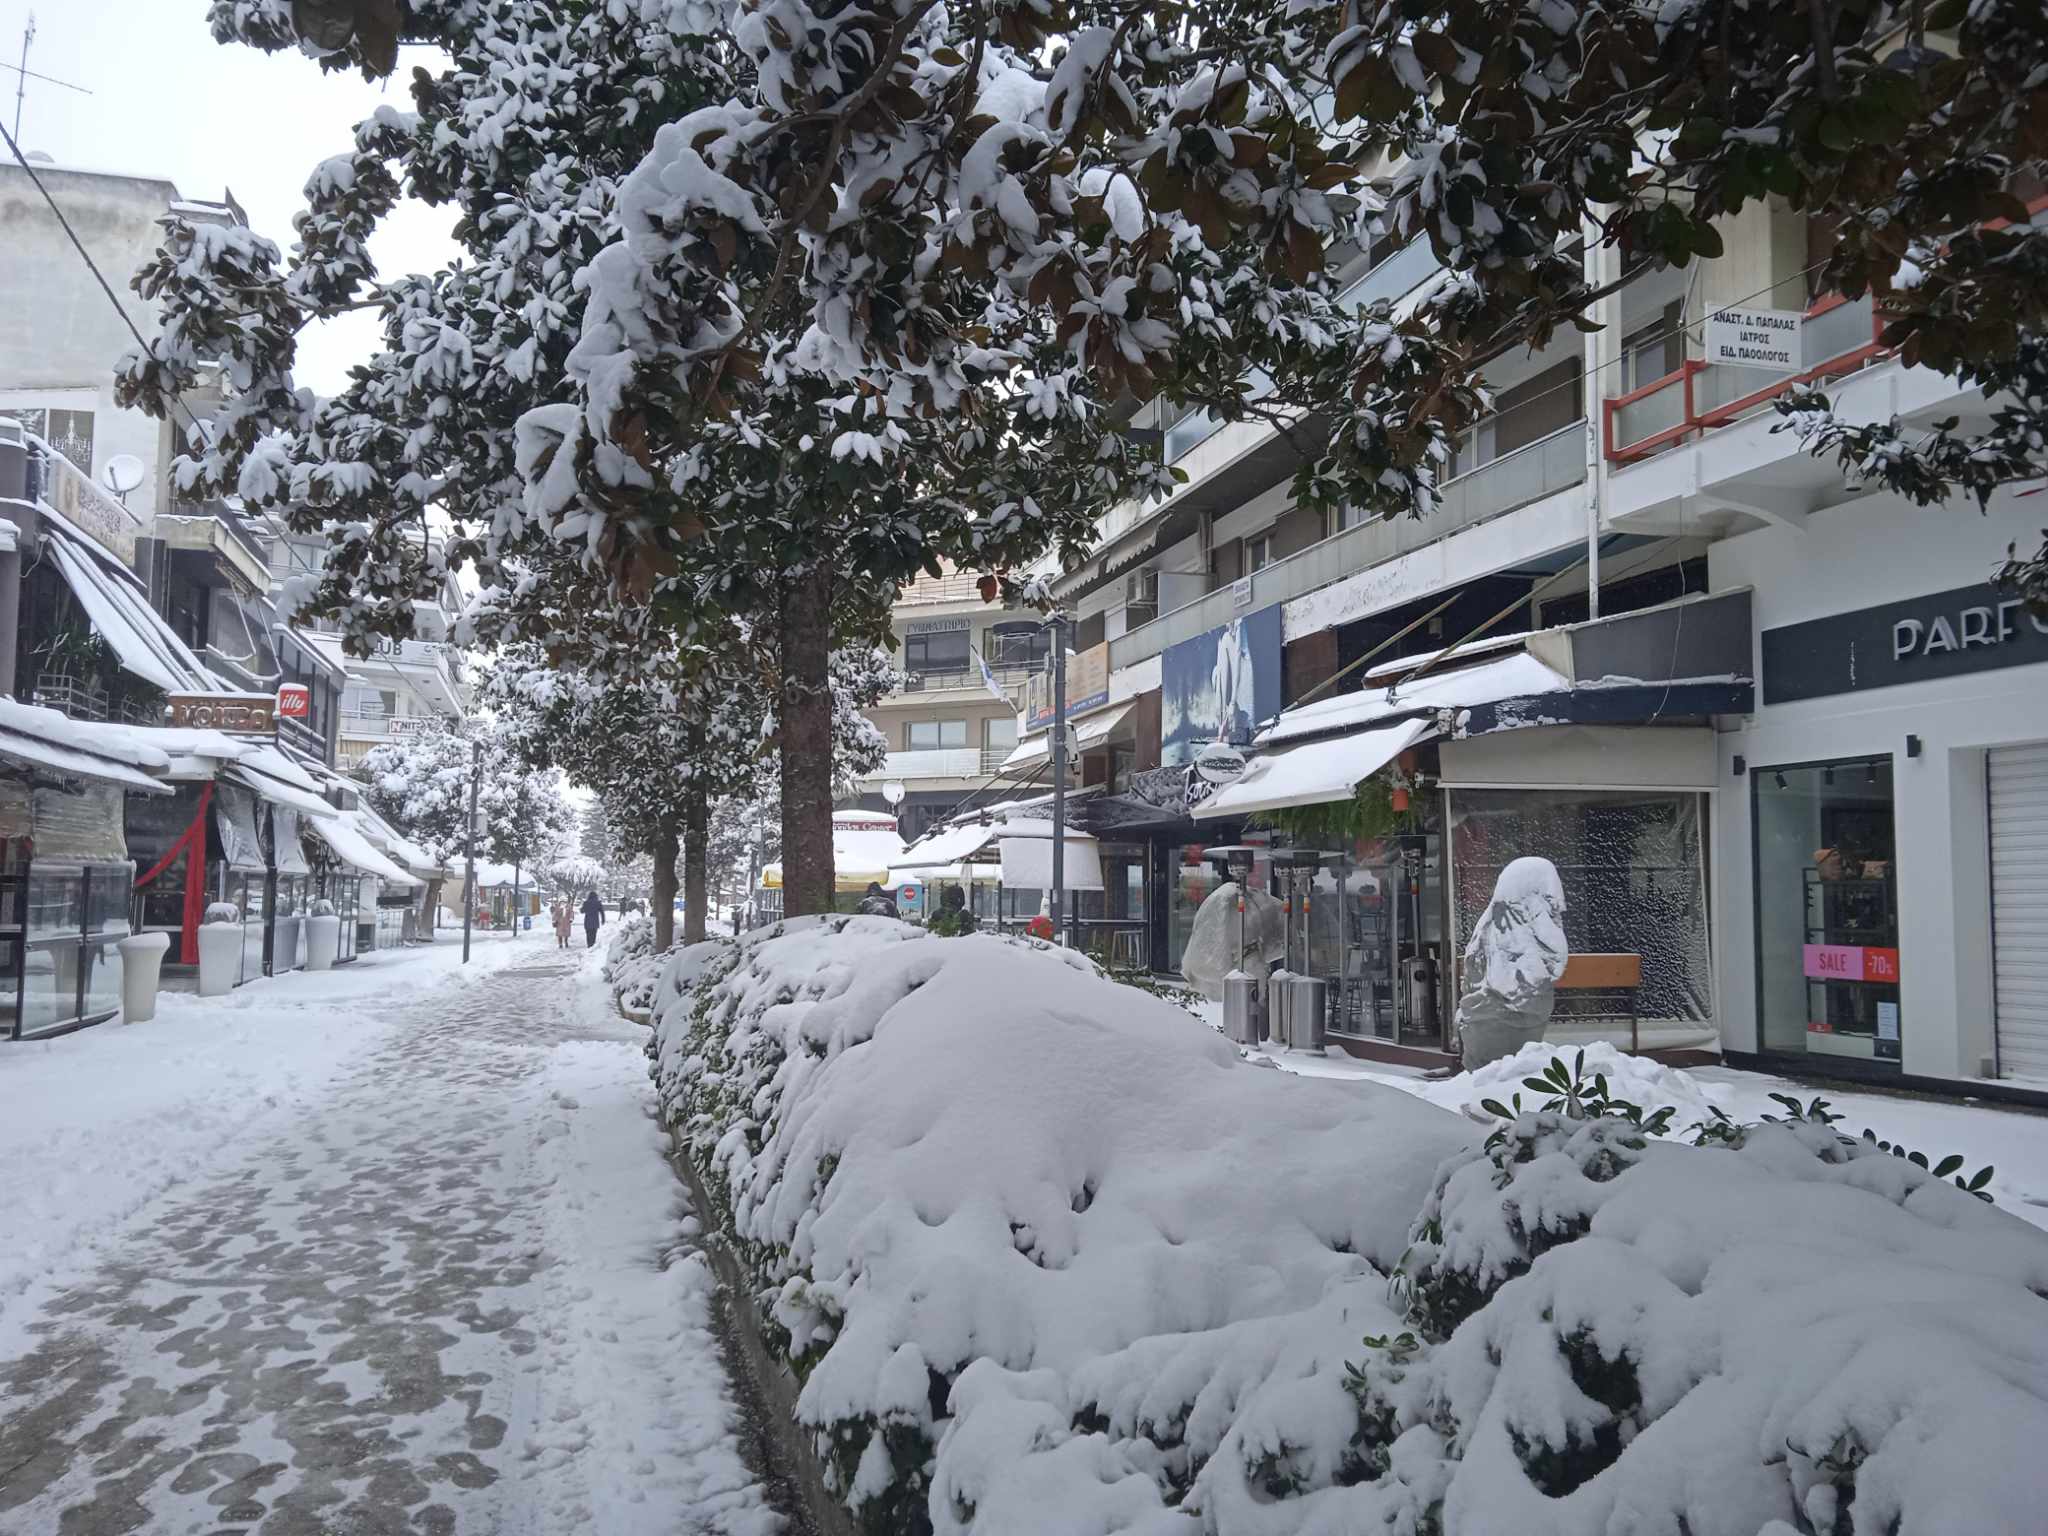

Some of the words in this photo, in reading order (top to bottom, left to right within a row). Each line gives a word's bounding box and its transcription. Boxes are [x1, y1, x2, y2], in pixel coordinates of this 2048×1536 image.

[1713, 311, 1744, 325] ΑΝΑΣΤ.
[1746, 315, 1754, 326] Δ.
[1756, 316, 1795, 330] ΠΑΠΑΛΑΣ
[1740, 331, 1770, 344] ΙΑΤΡΟΣ
[1720, 345, 1736, 357] ΕΙΔ.
[1738, 347, 1789, 362] ΠΑΘΟΛΟΓΟΣ
[281, 693, 305, 713] illy
[1819, 953, 1847, 972] SALE
